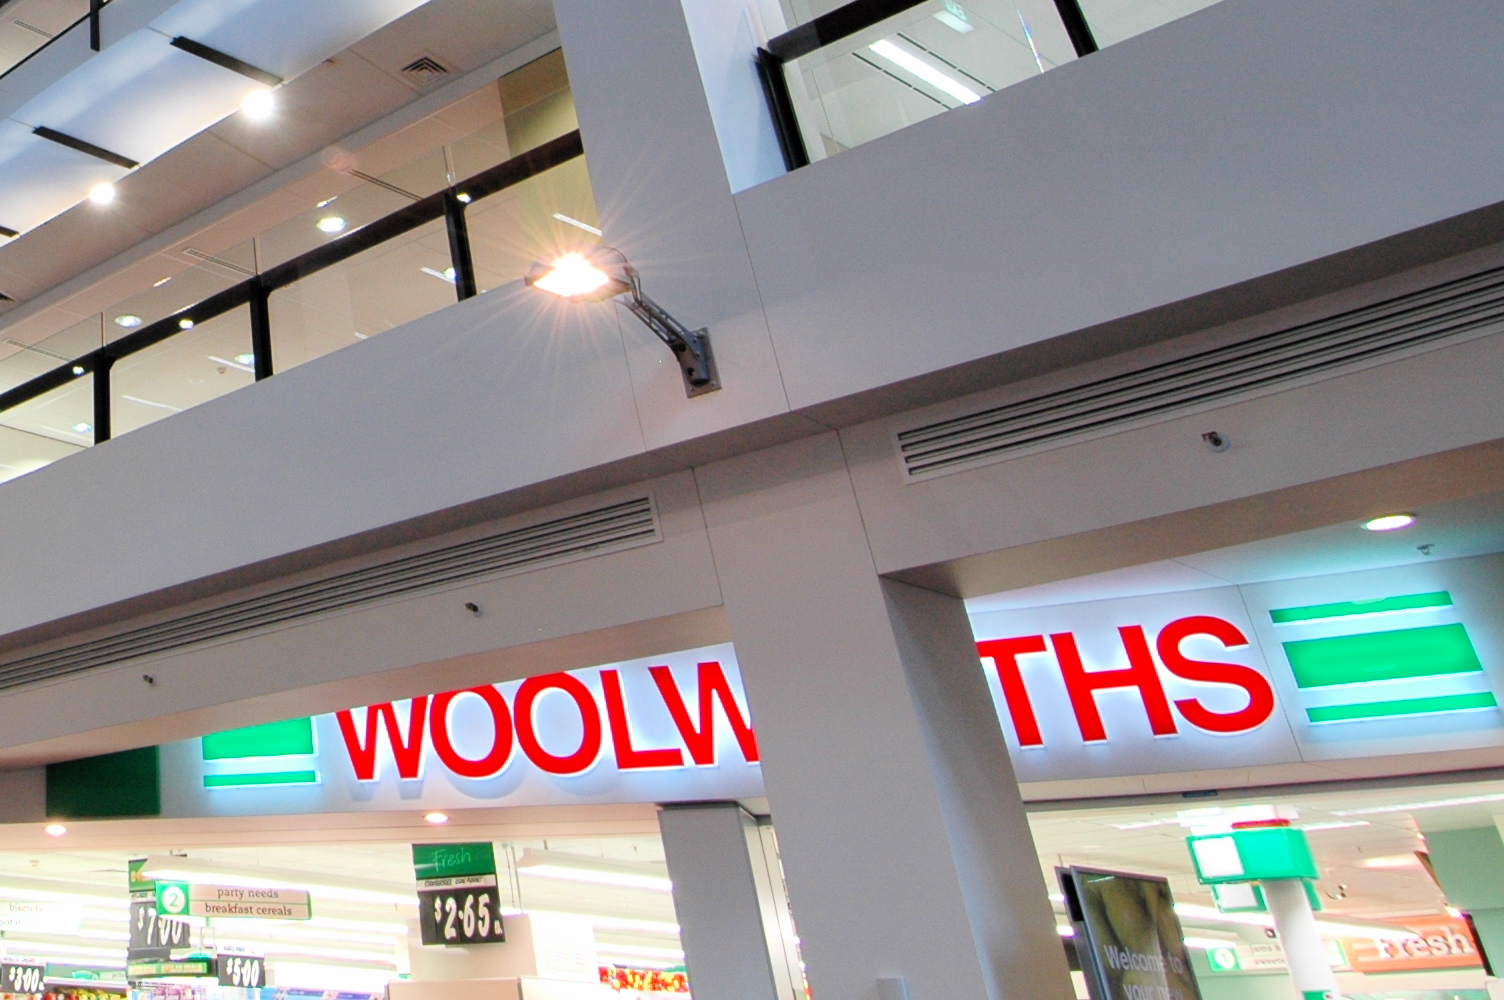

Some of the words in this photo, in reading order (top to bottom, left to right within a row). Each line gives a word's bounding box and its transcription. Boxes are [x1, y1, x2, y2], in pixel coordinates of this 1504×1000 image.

[335, 615, 1275, 781] WOOLWTHS
[432, 847, 471, 872] Fresh
[169, 892, 178, 906] 2
[217, 888, 244, 900] party
[248, 890, 279, 899] needs
[205, 903, 253, 915] breakfast
[256, 906, 293, 916] cereals
[1103, 945, 1167, 972] Welcome
[1167, 951, 1184, 974] to
